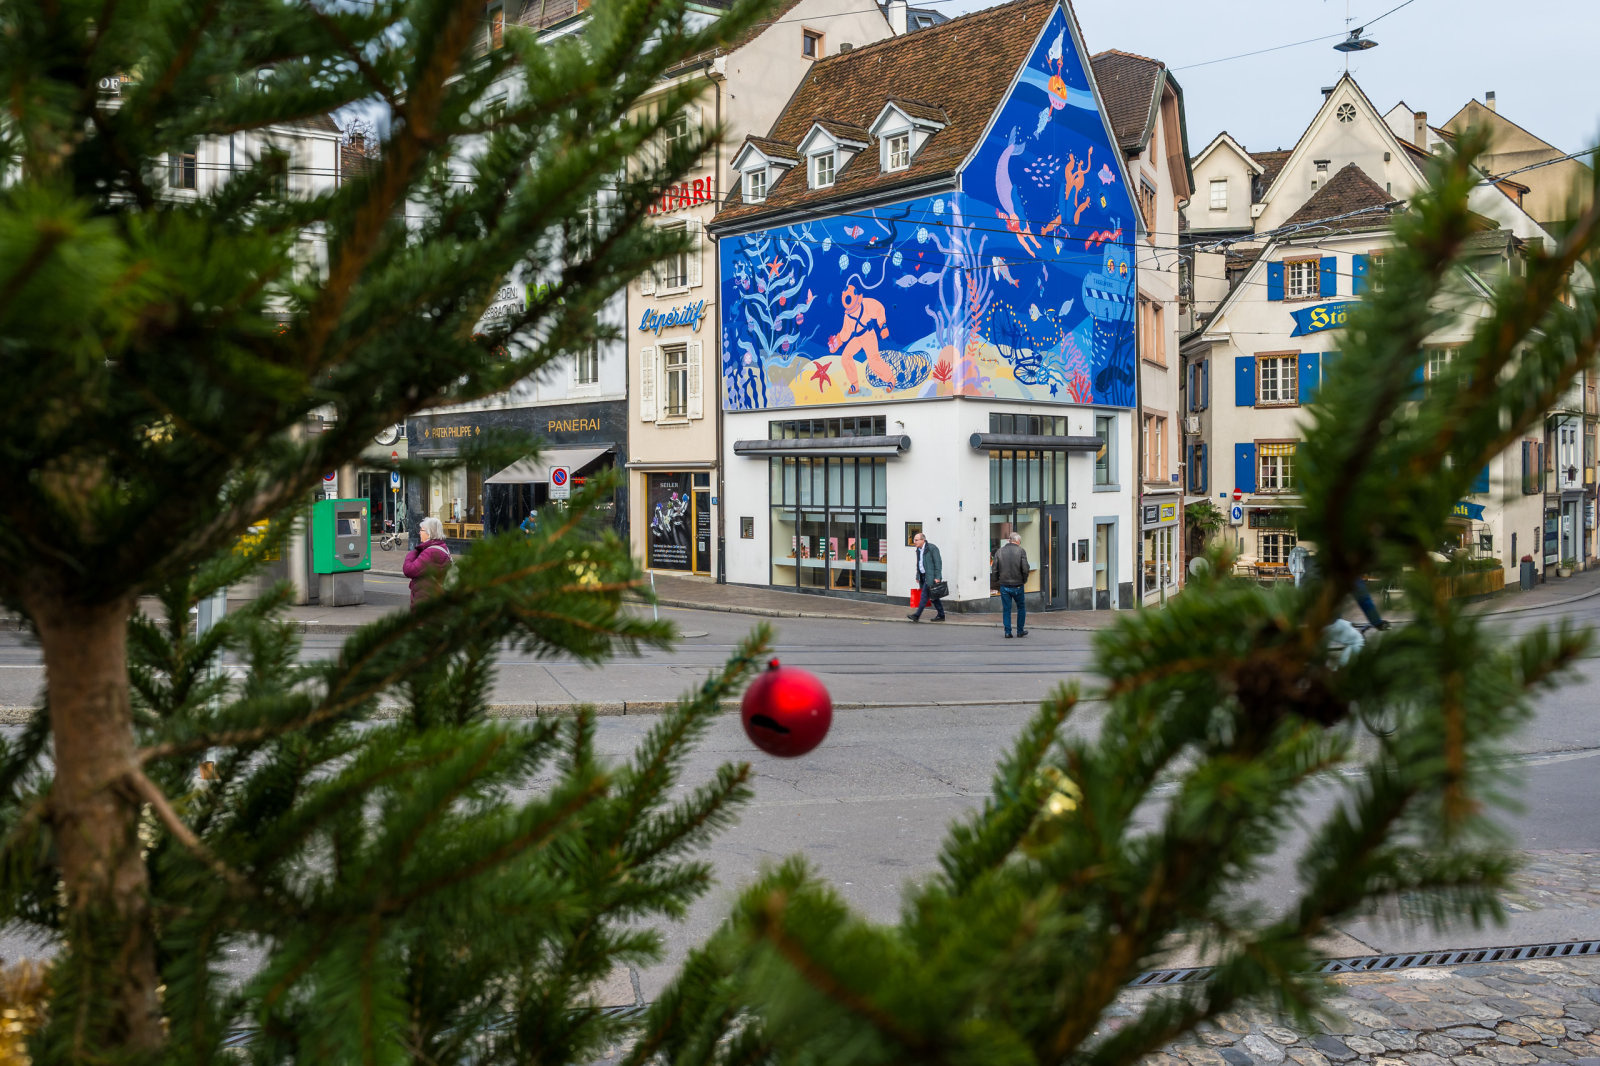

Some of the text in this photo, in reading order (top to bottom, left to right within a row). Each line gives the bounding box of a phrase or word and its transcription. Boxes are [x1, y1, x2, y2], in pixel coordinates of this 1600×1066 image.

[647, 176, 712, 215] MPARI
[638, 299, 704, 335] l'apéritif
[432, 425, 472, 438] PATEK PHILIPPE
[548, 418, 600, 433] PANERAI
[1453, 504, 1468, 516] kli
